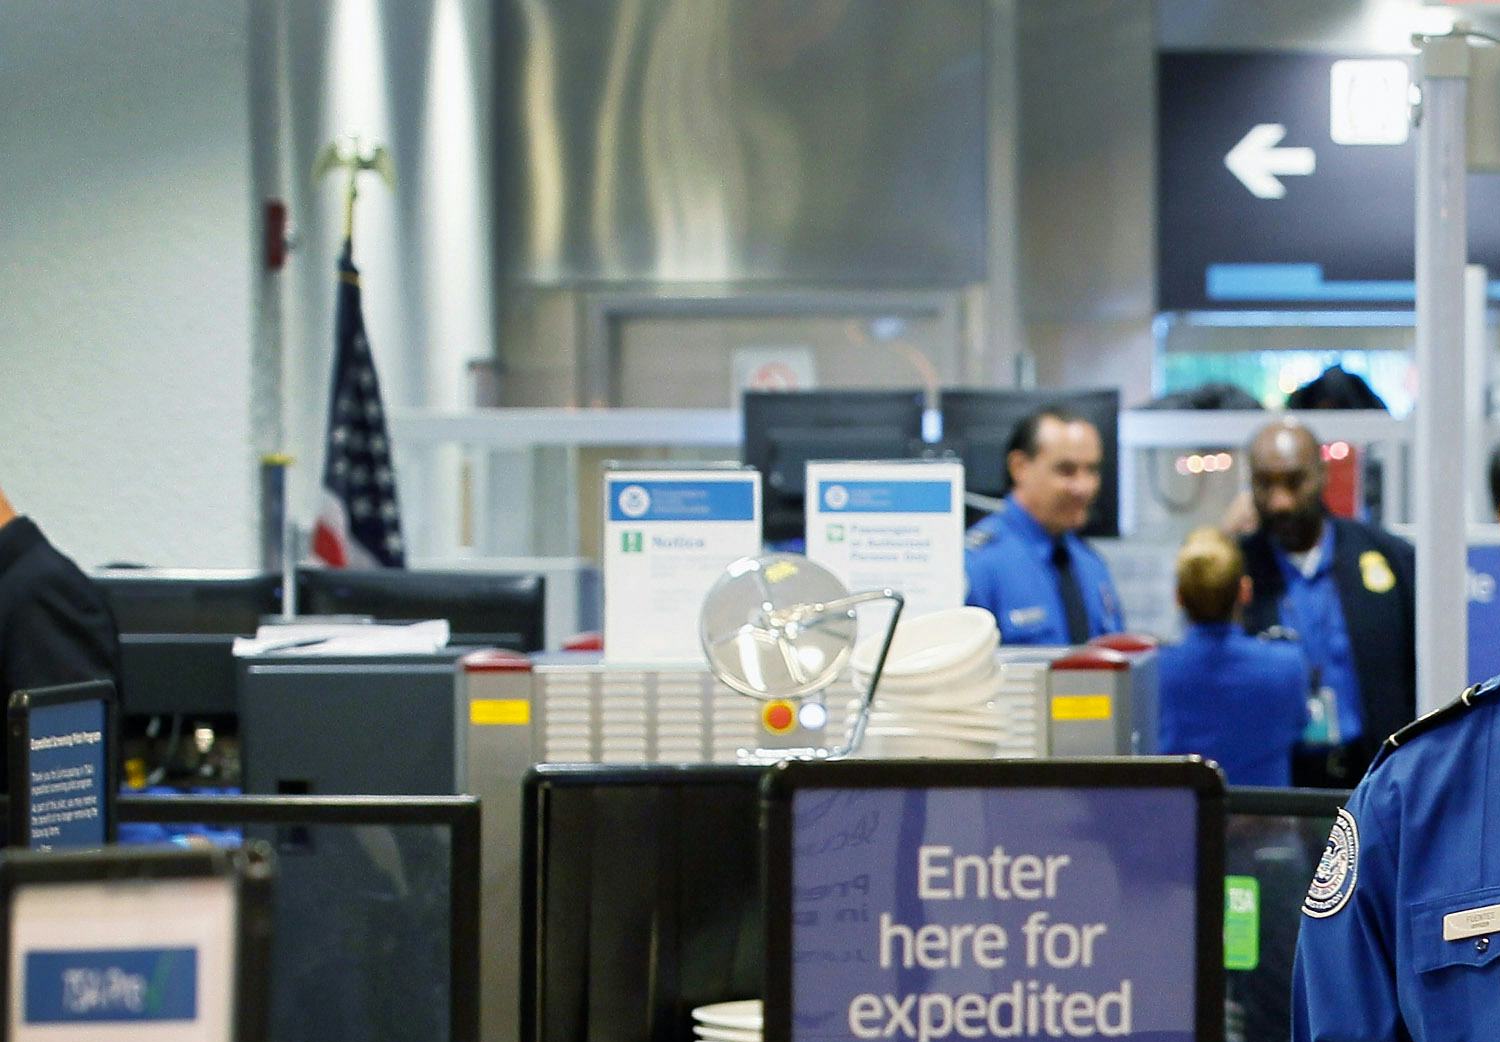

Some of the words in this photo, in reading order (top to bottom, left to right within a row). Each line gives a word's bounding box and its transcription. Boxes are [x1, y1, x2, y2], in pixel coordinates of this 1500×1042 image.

[917, 844, 1071, 901] Enter
[878, 912, 1009, 969] here
[1020, 910, 1108, 969] for
